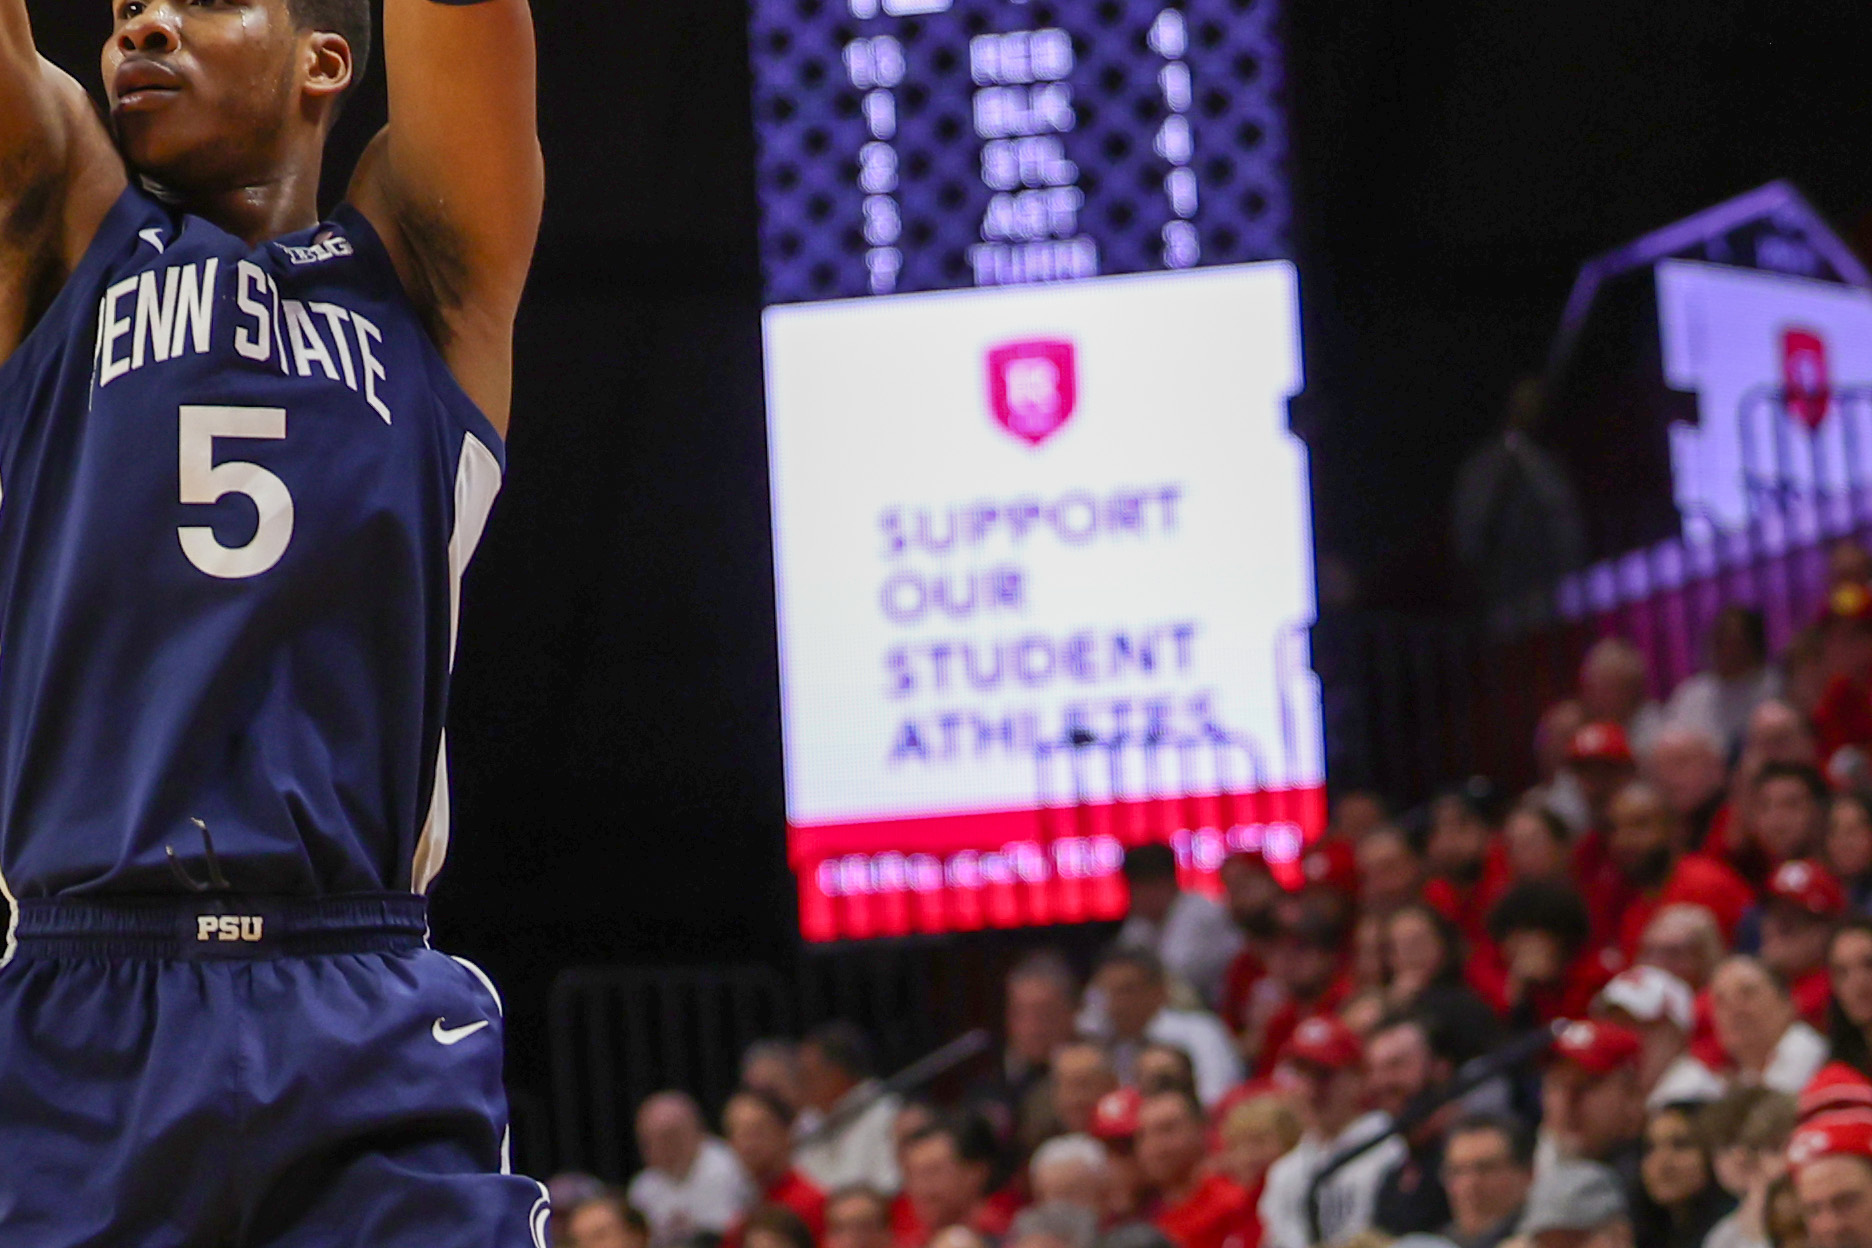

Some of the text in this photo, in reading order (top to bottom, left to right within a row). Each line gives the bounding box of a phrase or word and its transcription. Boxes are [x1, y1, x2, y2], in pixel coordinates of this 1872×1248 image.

[89, 257, 218, 412] ENN
[177, 405, 295, 579] 5
[880, 565, 1030, 627] OUR
[885, 621, 1196, 699] STUDENT
[197, 916, 264, 942] PSU
